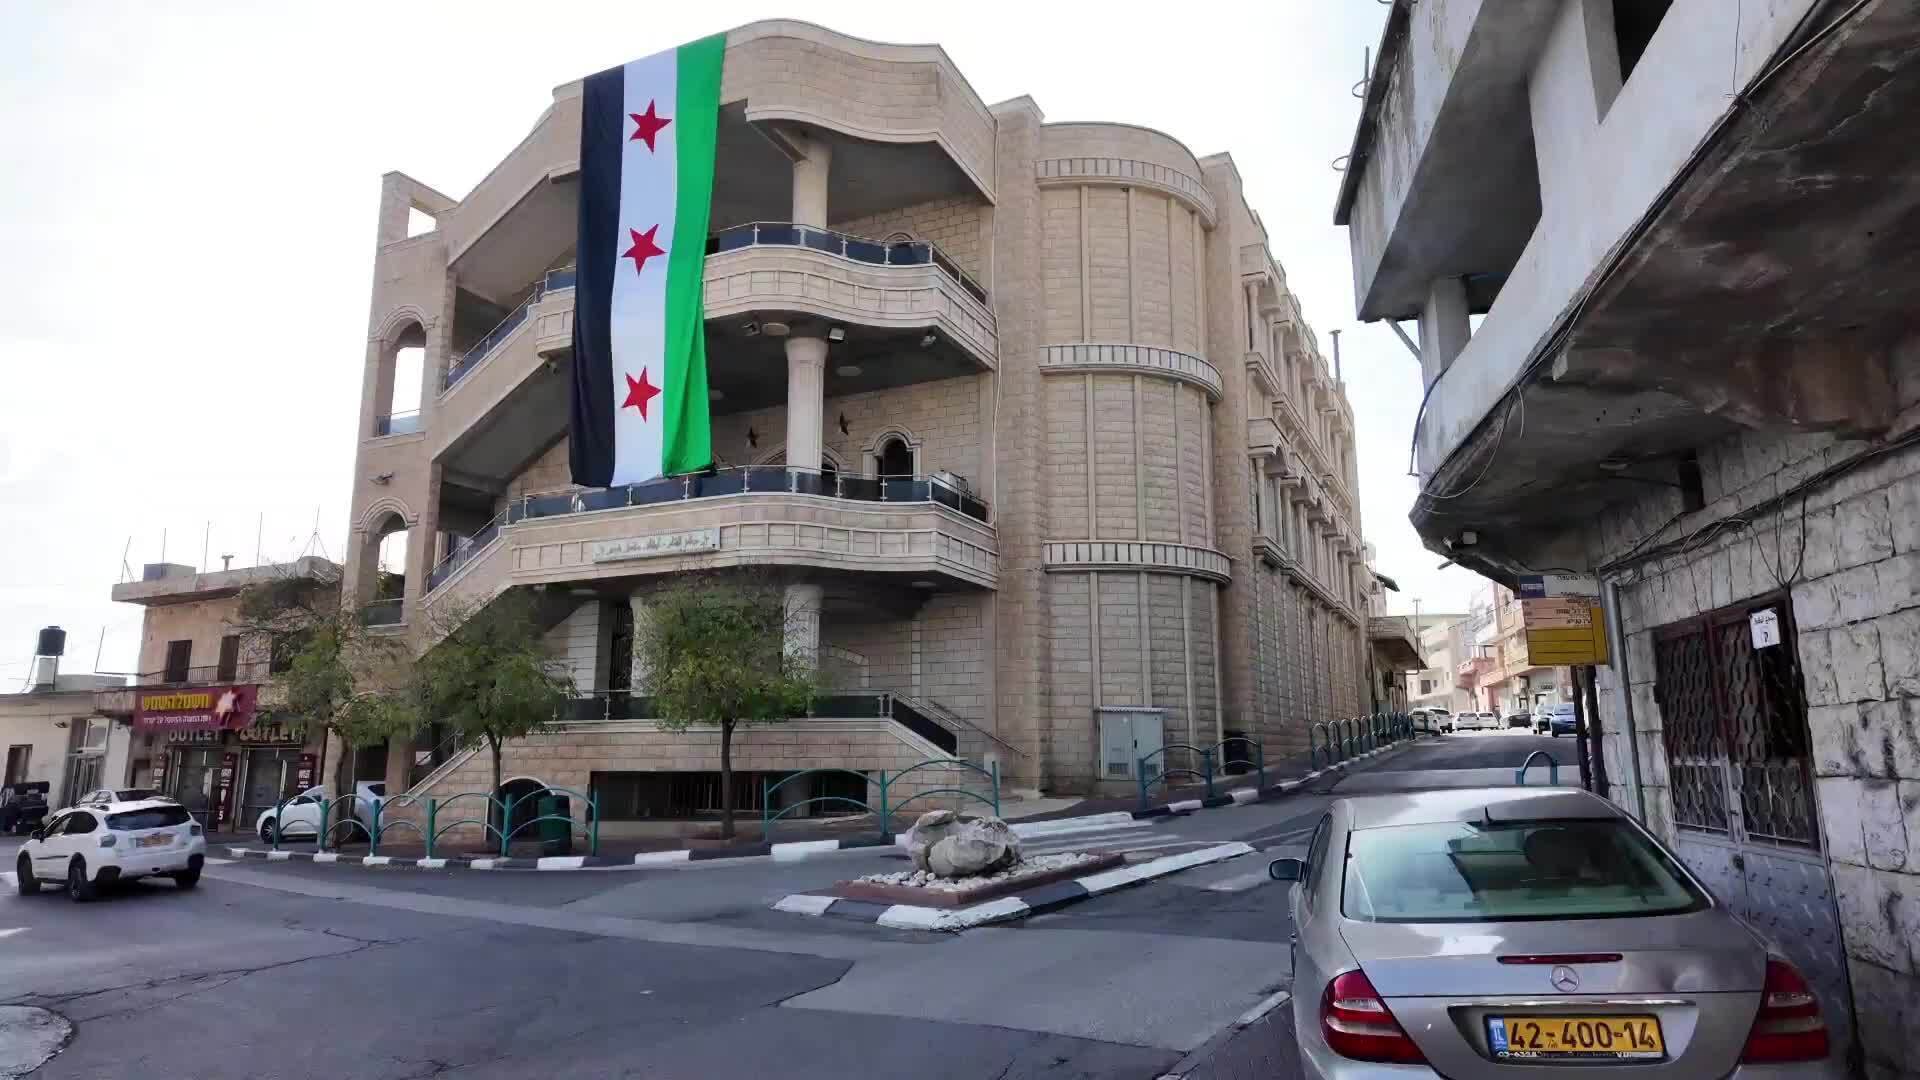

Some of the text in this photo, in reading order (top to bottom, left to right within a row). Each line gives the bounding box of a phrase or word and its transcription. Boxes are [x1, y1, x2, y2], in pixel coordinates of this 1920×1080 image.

[168, 728, 219, 742] OUTLET
[240, 727, 296, 742] OUTLET
[1510, 1021, 1656, 1049] 42-400-14
